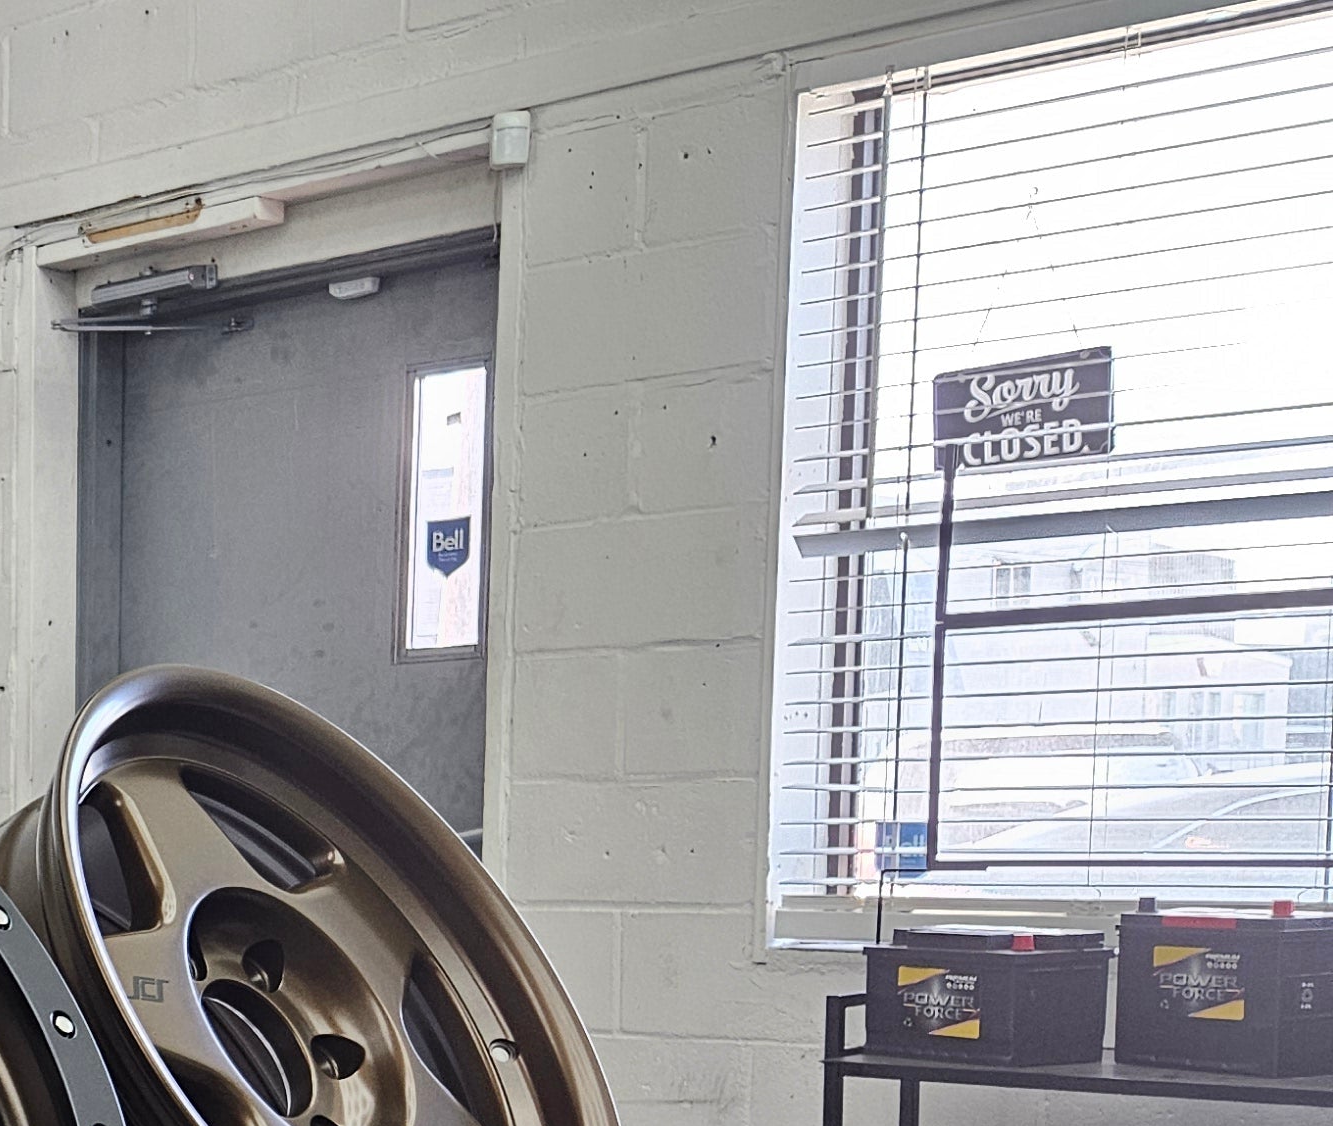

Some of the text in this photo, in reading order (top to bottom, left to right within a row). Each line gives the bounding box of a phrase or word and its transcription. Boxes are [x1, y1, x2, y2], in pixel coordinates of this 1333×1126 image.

[963, 368, 1080, 423] Sorry
[1001, 409, 1042, 427] WE'RE
[432, 527, 464, 552] Bell
[1160, 973, 1238, 988] POWER
[903, 992, 974, 1008] POWER
[1173, 986, 1223, 1000] FORCE
[915, 1006, 962, 1020] FORCE
